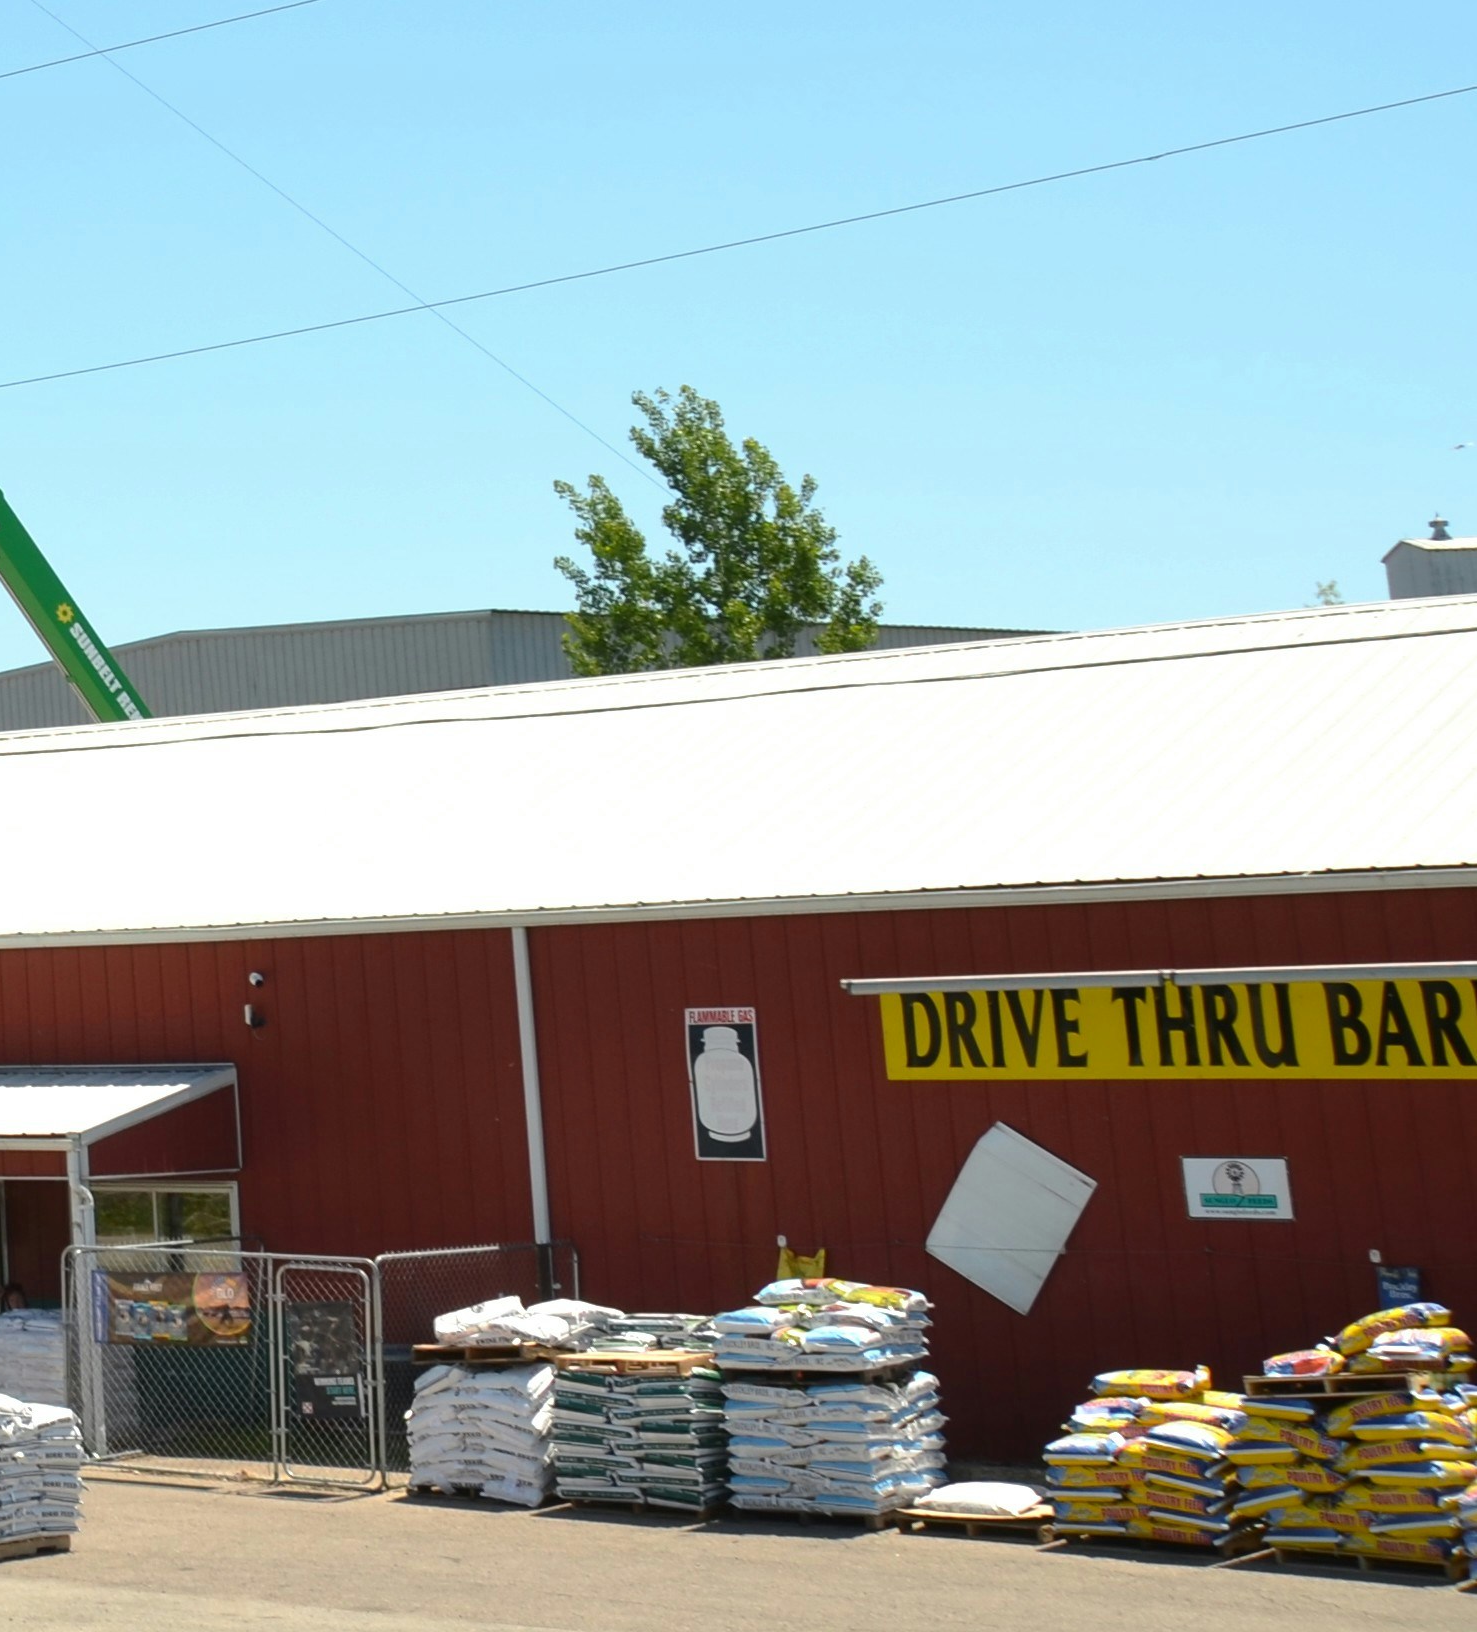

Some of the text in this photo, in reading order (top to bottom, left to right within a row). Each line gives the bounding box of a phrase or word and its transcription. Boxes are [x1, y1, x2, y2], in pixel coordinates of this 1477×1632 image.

[69, 622, 122, 693] SUNBELT
[689, 1009, 753, 1024] FLAMMABLE GAS
[900, 979, 1477, 1068] DRIVE THRU BAR
